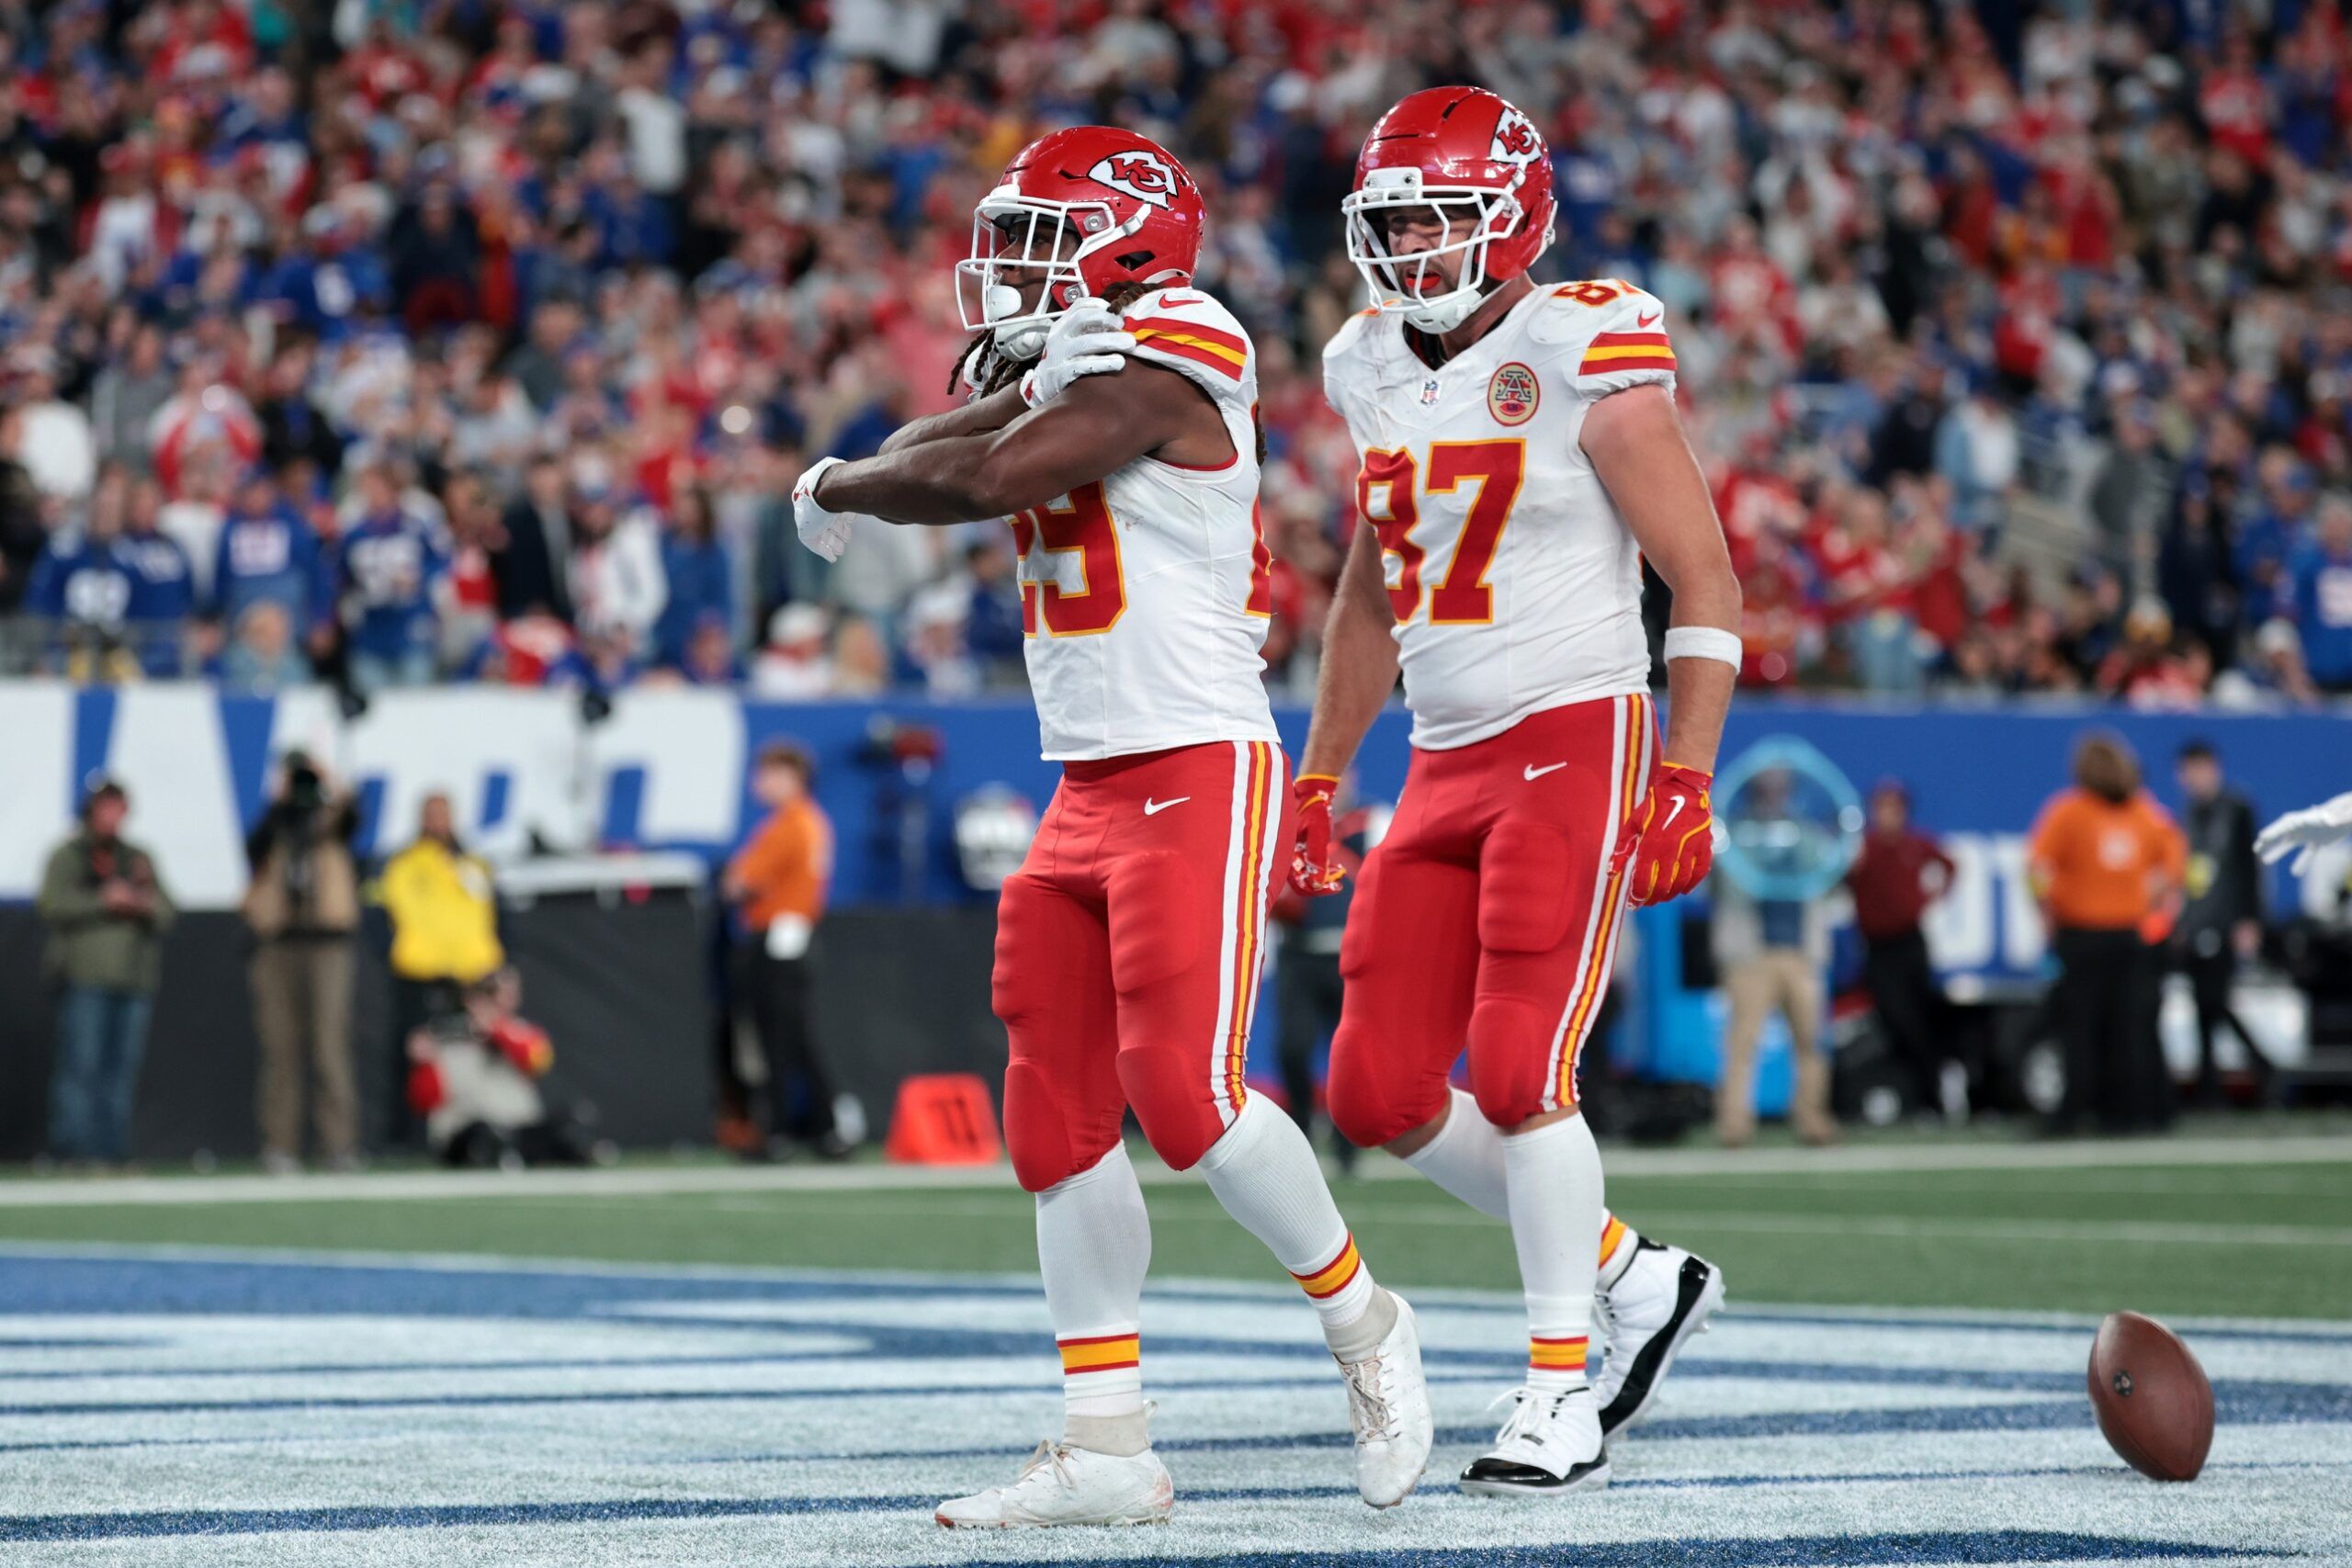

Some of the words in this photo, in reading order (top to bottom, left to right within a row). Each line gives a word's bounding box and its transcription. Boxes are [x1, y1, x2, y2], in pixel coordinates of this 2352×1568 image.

[1107, 158, 1168, 194] KC
[1551, 280, 1641, 308] 8
[1496, 371, 1532, 402] A
[1355, 438, 1526, 626] 87
